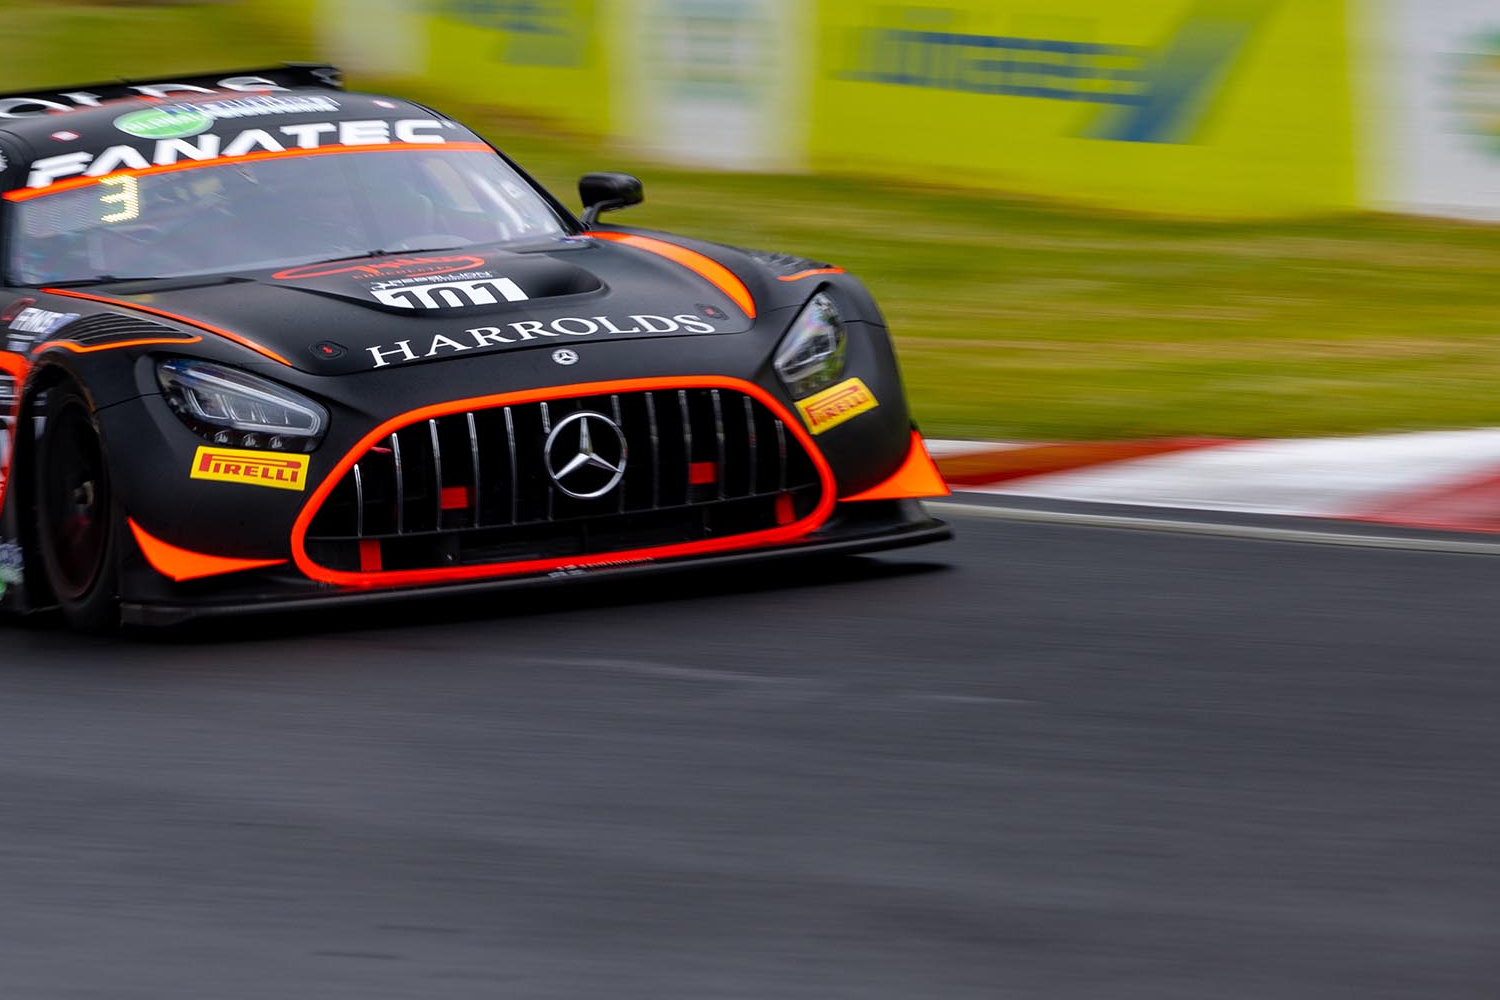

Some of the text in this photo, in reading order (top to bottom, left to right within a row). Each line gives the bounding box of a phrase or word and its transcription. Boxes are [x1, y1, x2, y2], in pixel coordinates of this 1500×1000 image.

[26, 119, 446, 190] FANATEC
[100, 175, 140, 224] 3
[366, 314, 716, 368] HARROLDS
[804, 385, 871, 426] PIRELLI
[199, 453, 302, 483] PIRELLI
